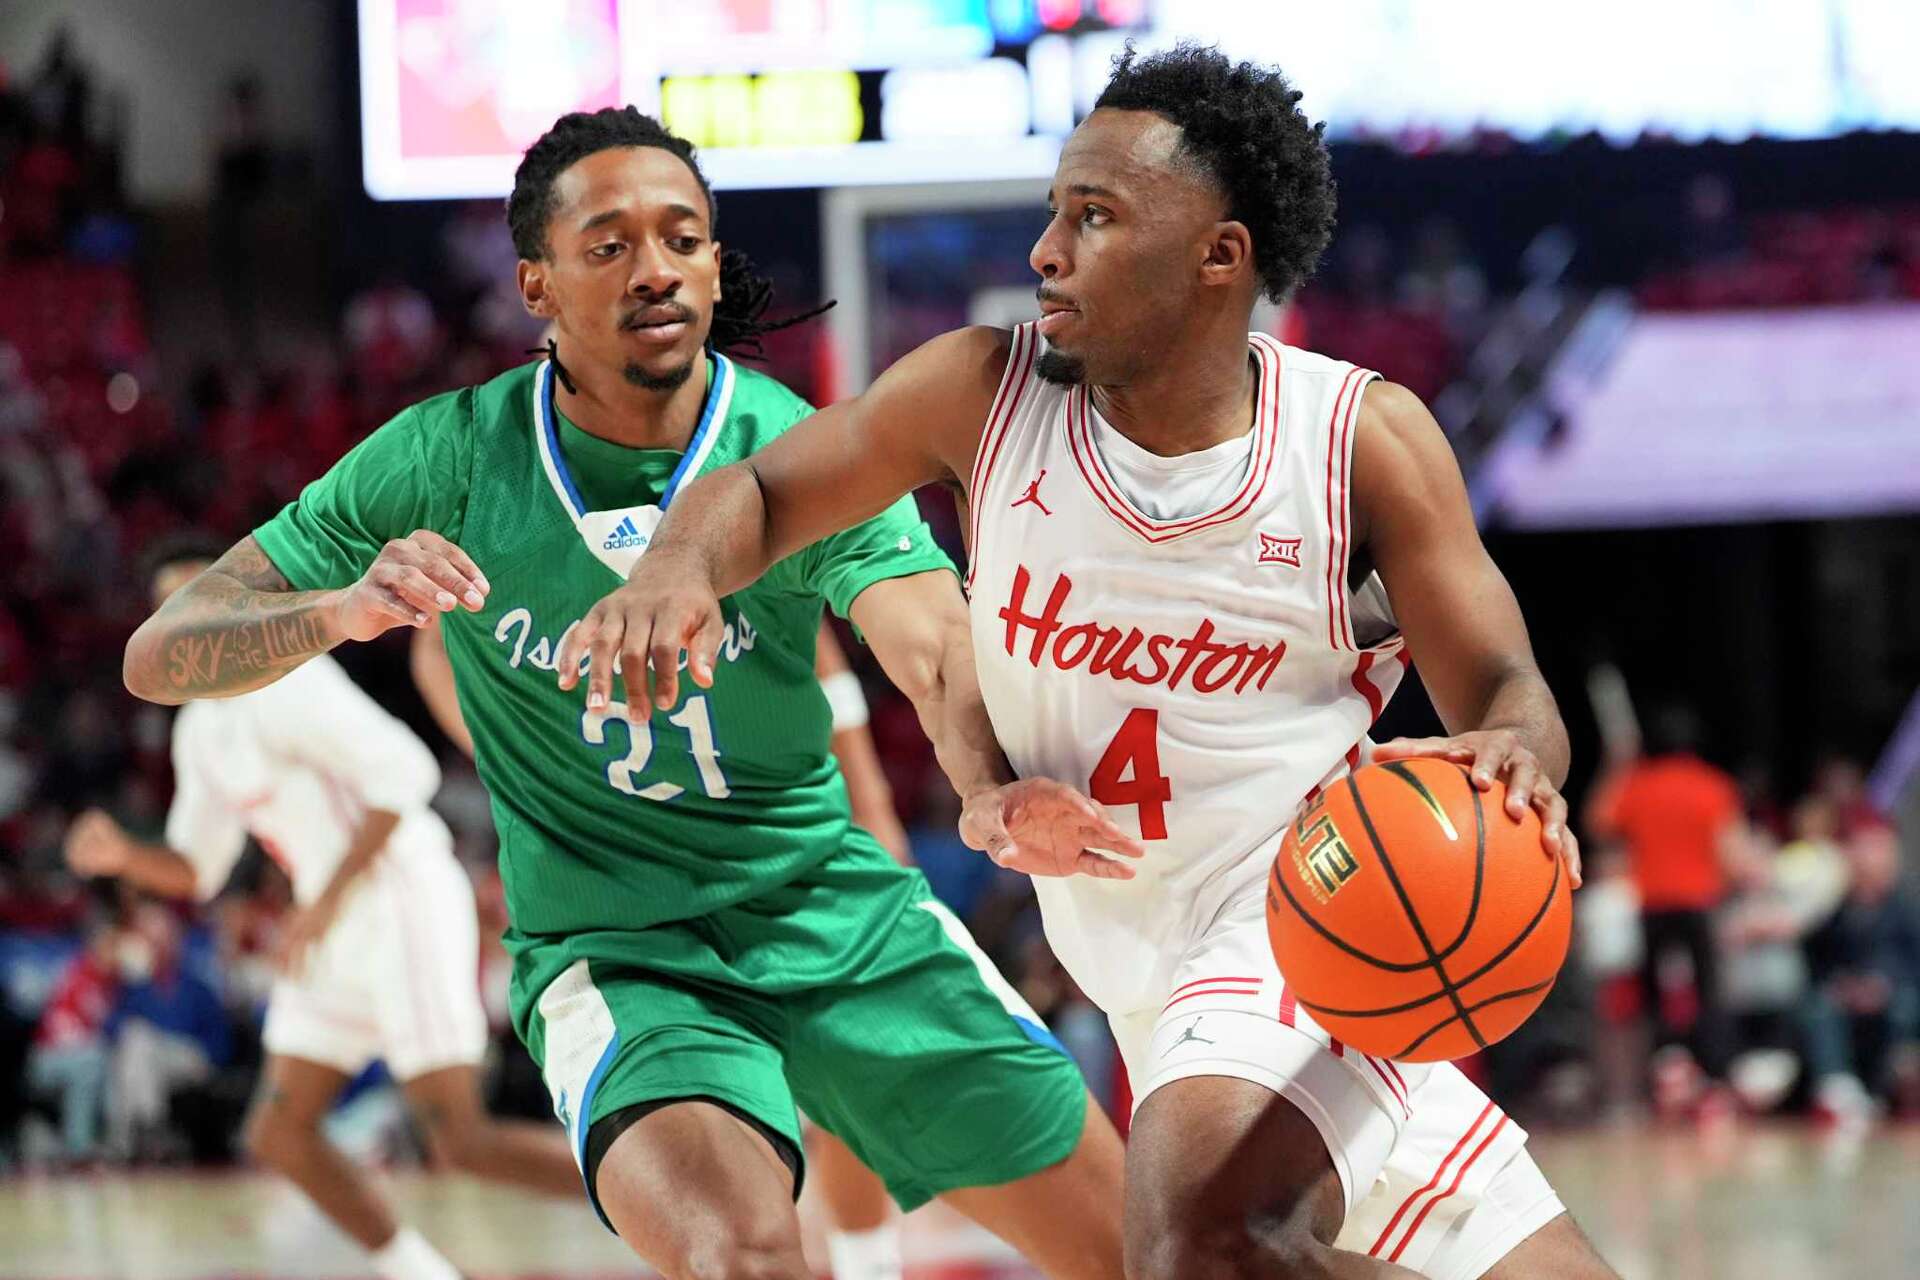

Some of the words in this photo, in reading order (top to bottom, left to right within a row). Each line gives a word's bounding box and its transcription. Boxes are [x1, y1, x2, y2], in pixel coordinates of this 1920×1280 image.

[603, 535, 647, 550] adidas
[1262, 539, 1298, 561] XII
[232, 622, 250, 650] IS
[261, 614, 326, 665] LIMIT
[998, 563, 1288, 695] Houston
[169, 631, 227, 687] SKY
[224, 649, 268, 672] THE
[582, 695, 732, 801] 21
[1089, 707, 1171, 841] 4
